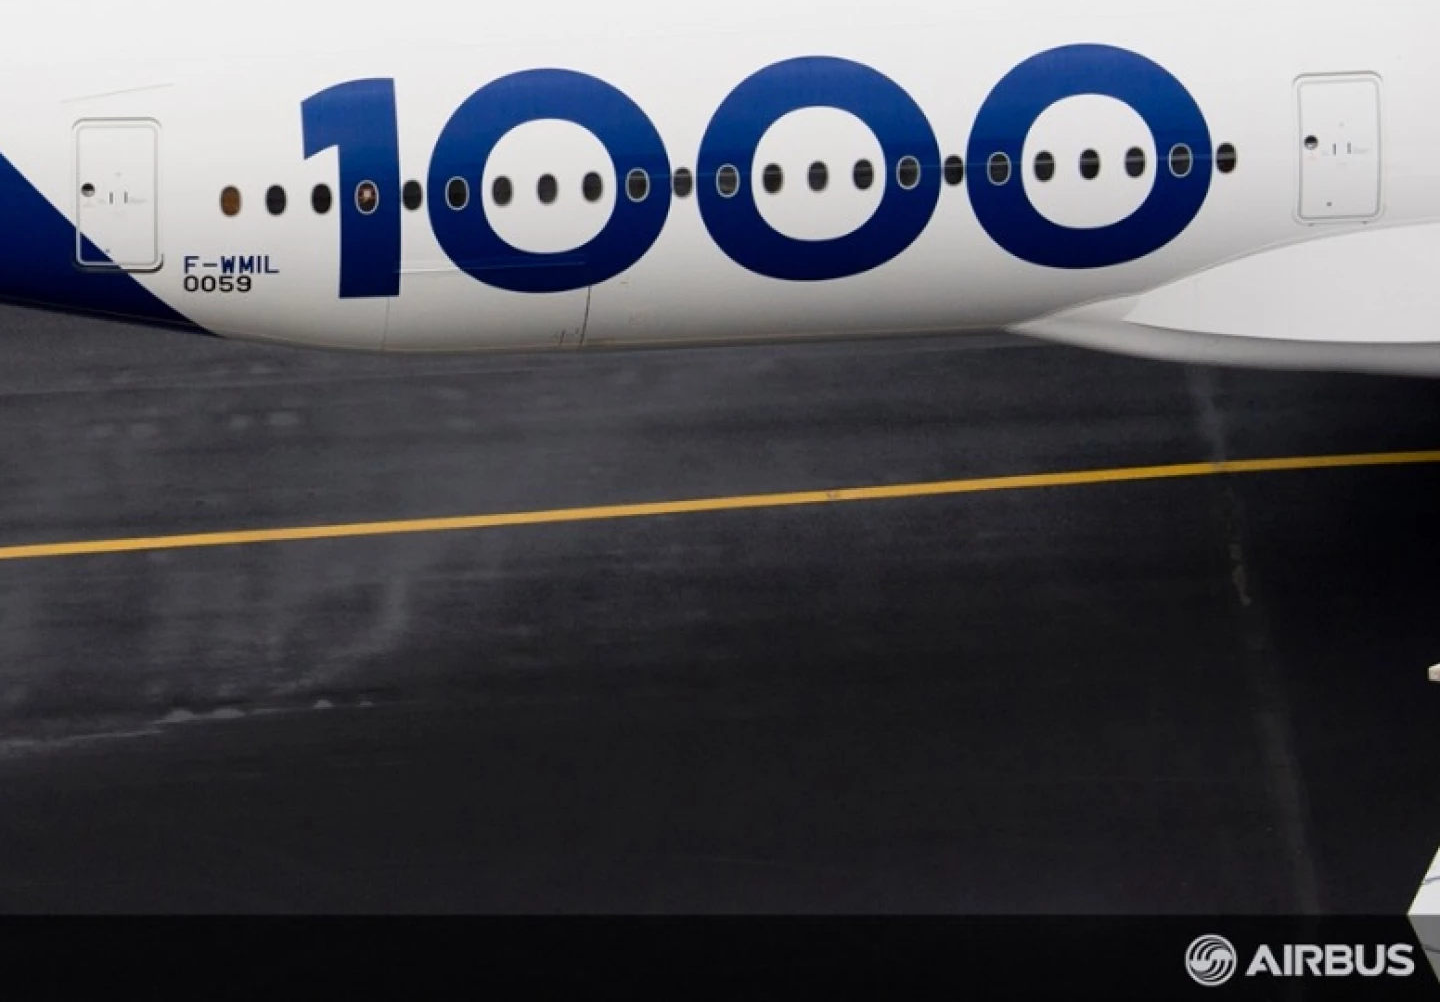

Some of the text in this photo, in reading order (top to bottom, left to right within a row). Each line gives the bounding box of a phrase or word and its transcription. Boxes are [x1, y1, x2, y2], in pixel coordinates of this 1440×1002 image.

[301, 42, 1212, 298] 1000
[183, 255, 280, 274] F-WMIL
[183, 275, 252, 293] 0059
